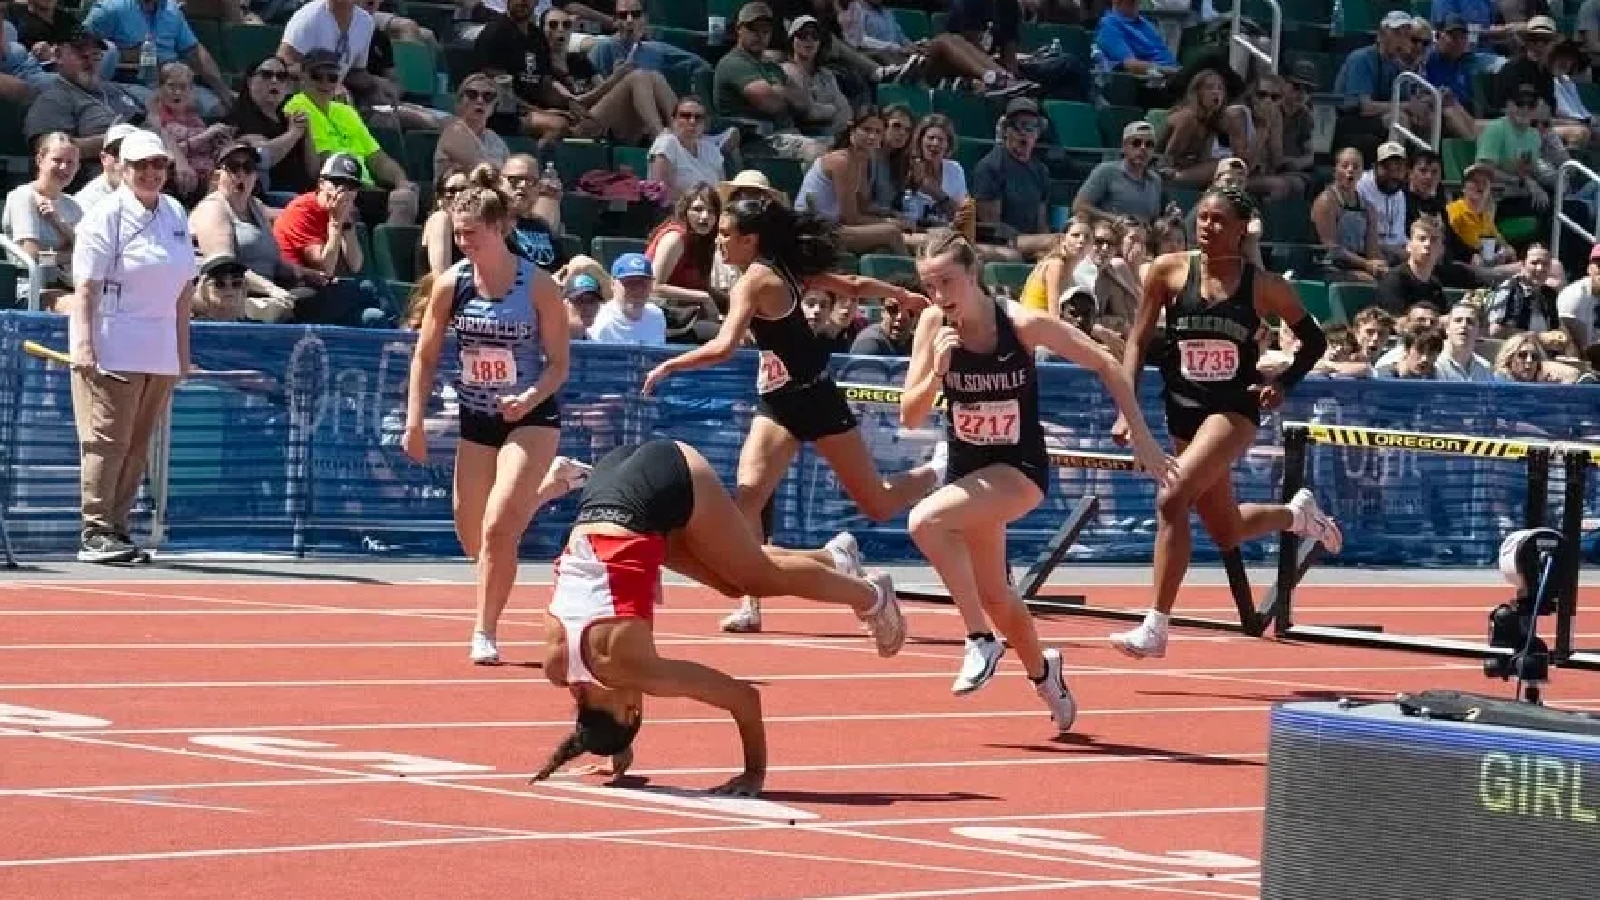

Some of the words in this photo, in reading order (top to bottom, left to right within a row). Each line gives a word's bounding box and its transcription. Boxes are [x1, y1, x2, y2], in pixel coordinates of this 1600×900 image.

[1185, 350, 1235, 371] 1735
[846, 388, 900, 402] OREG
[957, 413, 1016, 436] 2717
[1479, 752, 1598, 822] GIRL
